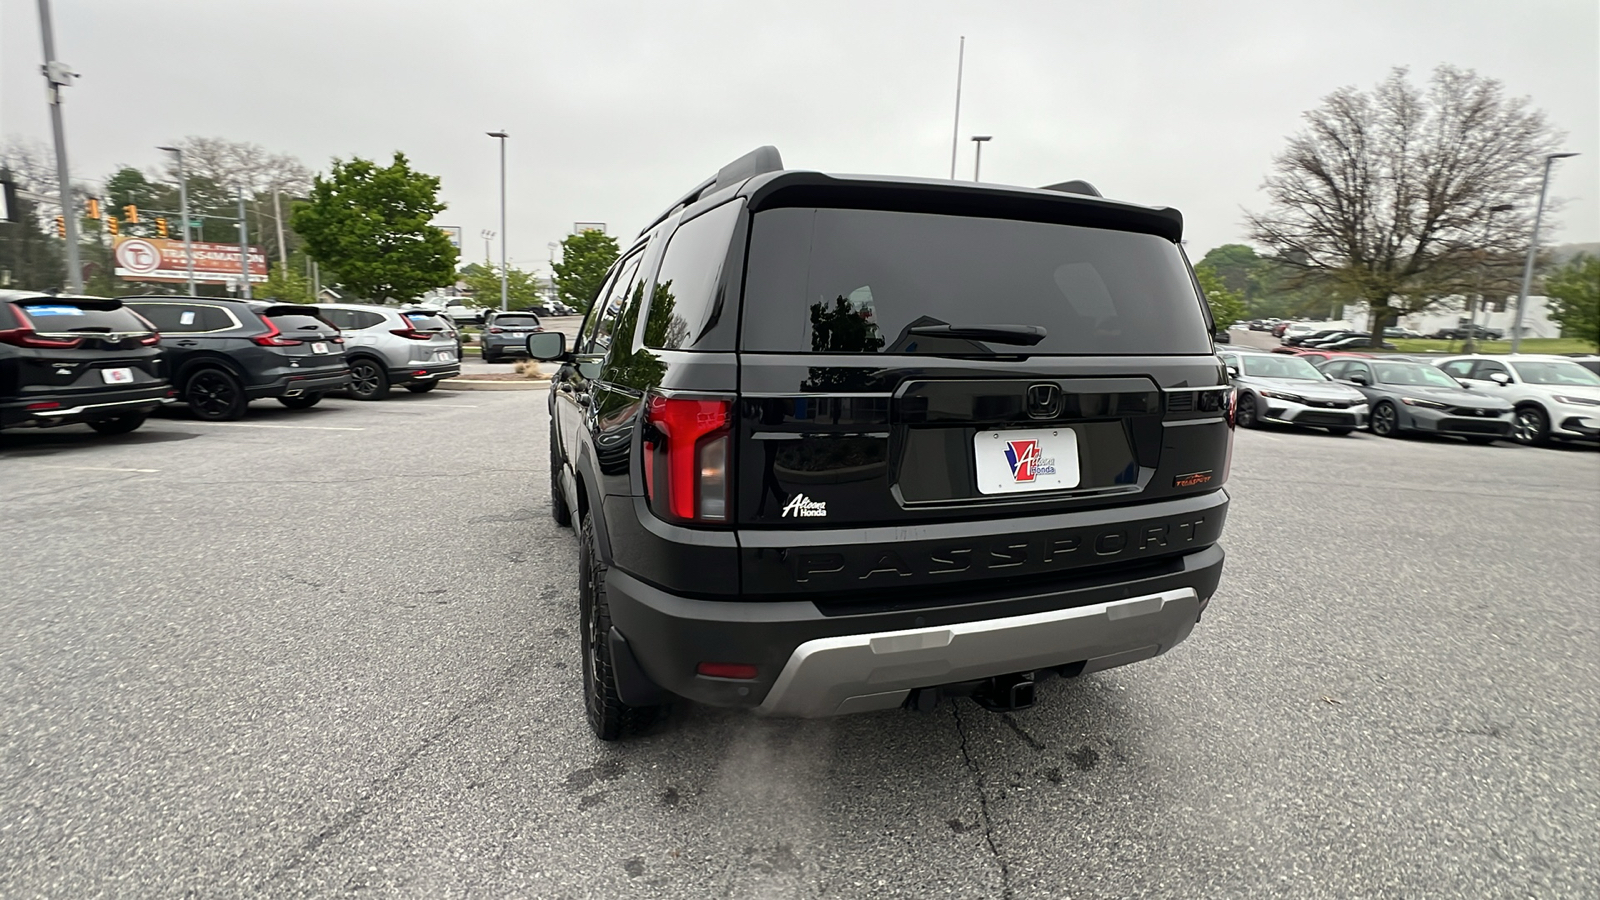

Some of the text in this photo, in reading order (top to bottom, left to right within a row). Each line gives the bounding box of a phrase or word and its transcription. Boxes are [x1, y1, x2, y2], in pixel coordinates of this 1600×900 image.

[160, 248, 265, 264] TRANS4MATON
[1030, 466, 1056, 475] Honda
[800, 508, 827, 517] Honda
[795, 518, 1206, 583] PASSPORT
